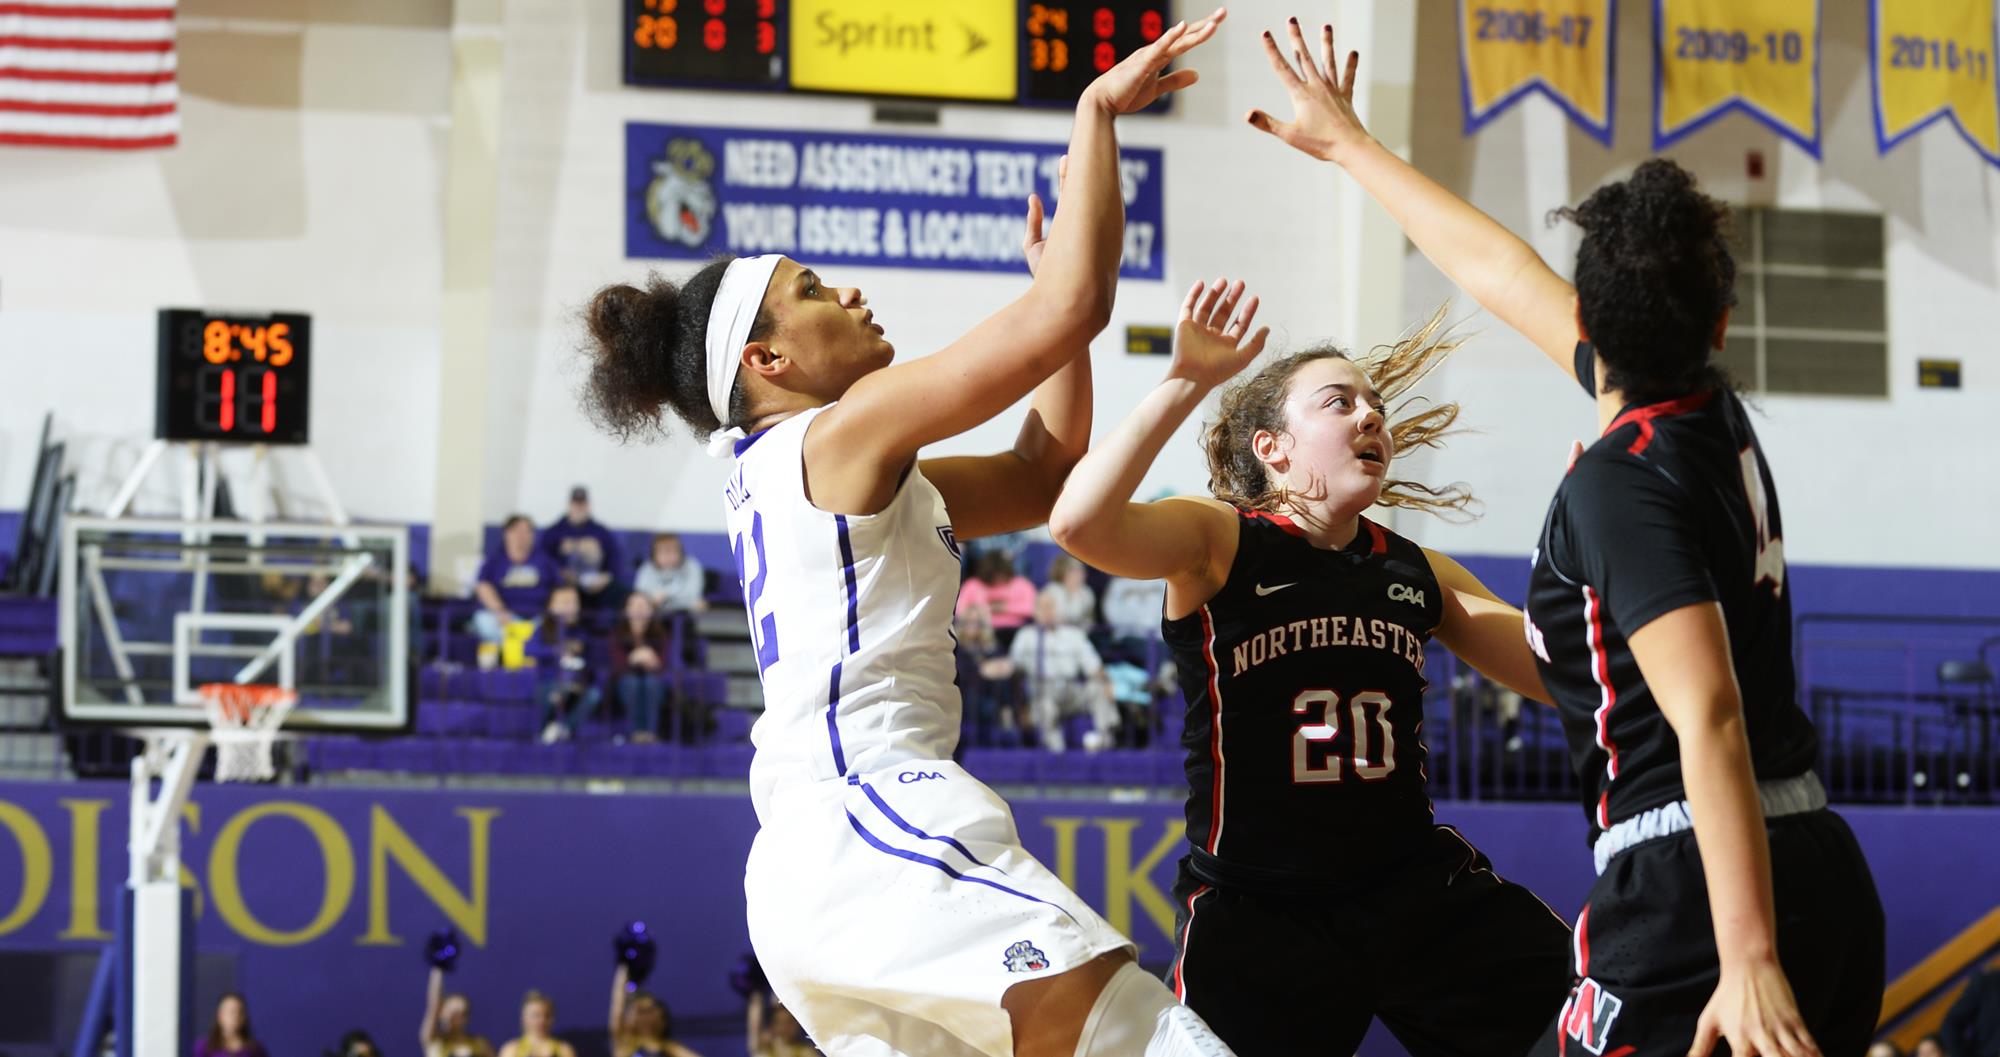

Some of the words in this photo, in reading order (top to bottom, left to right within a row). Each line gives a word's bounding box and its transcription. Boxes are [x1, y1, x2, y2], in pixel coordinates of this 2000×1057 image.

[634, 15, 678, 50] 20
[815, 9, 937, 58] Sprint
[1677, 26, 1803, 65] 2009-10
[724, 139, 798, 188] NEED
[800, 141, 972, 196] ASSISTANCE?
[976, 151, 1036, 199] TEXT
[722, 203, 797, 251] YOUR
[801, 205, 880, 257] ISSUE
[883, 208, 906, 259] &
[203, 320, 293, 367] 8:45
[219, 368, 277, 433] 11
[1387, 583, 1426, 608] CAA
[1232, 616, 1426, 678] NORTHEASTER
[1292, 688, 1396, 783] 20
[898, 771, 947, 784] CAA
